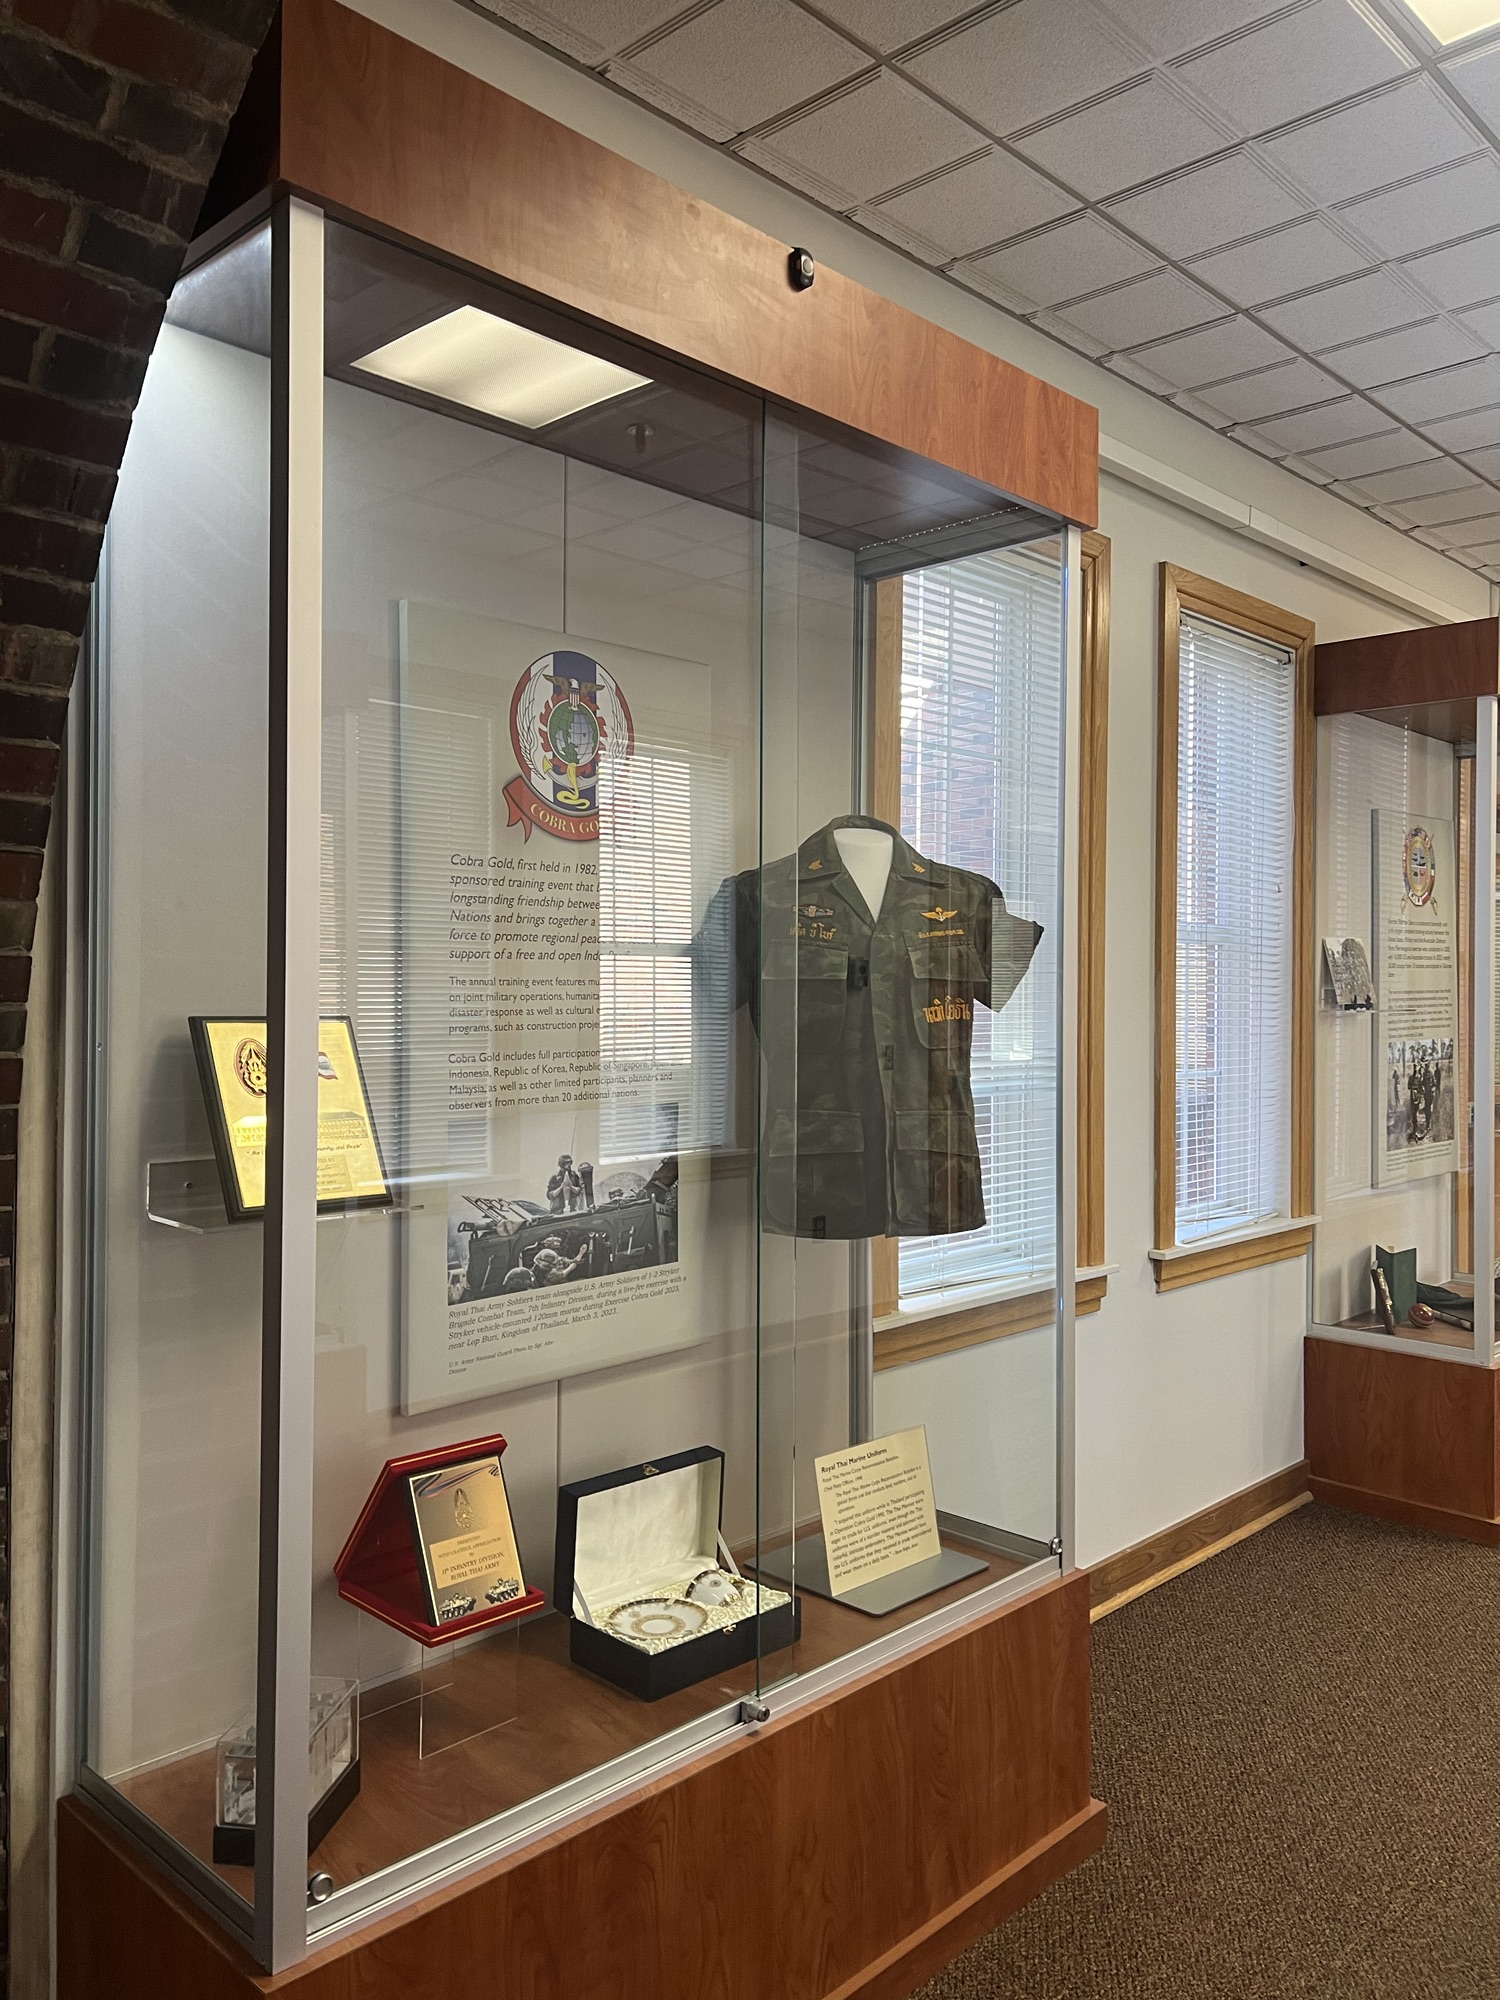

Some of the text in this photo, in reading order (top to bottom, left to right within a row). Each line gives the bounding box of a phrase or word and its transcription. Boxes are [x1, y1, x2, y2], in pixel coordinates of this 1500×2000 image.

[530, 804, 575, 833] COBRA
[451, 854, 483, 867] Cobra
[488, 857, 514, 870] Gold,
[517, 859, 537, 871] first
[540, 861, 560, 872] held
[563, 863, 570, 873] in
[575, 864, 598, 876] 1982,
[450, 875, 505, 887] sponsored
[508, 878, 545, 892] training
[548, 881, 573, 891] event
[576, 881, 594, 892] that
[451, 891, 514, 908] longstanding
[517, 895, 564, 910] friendship
[567, 898, 601, 909] betwee
[450, 910, 595, 928] Nations and brings together a
[450, 929, 476, 940] force
[481, 931, 491, 941] to
[494, 932, 538, 944] promote
[541, 933, 579, 945] regional
[449, 949, 490, 962] support
[494, 949, 506, 960] of
[507, 951, 512, 960] a
[516, 949, 535, 960] free
[538, 949, 554, 960] and
[558, 952, 581, 964] open
[449, 977, 466, 986] The
[469, 977, 496, 986] annual
[499, 978, 529, 988] training
[532, 979, 553, 987] event
[556, 977, 585, 986] features
[450, 991, 600, 1004] on joint military operations, humanita
[450, 1008, 483, 1017] disaster
[486, 1009, 523, 1018] response
[537, 1006, 552, 1015] well
[566, 1006, 594, 1015] cultural
[449, 1021, 600, 1035] programs, such as construction proje
[448, 1053, 476, 1064] Cobra
[479, 1052, 500, 1063] Gold
[503, 1051, 536, 1061] includes
[538, 1050, 550, 1060] full
[553, 1049, 600, 1060] participation
[449, 1069, 491, 1079] Indonesia,
[494, 1067, 528, 1078] Republic
[532, 1065, 540, 1075] of
[542, 1064, 567, 1074] Korea,
[569, 1062, 601, 1074] Republic
[604, 1062, 612, 1070] of
[613, 1060, 650, 1071] Singapore,
[450, 1085, 486, 1096] Malaysia,
[500, 1082, 516, 1091] well
[530, 1081, 552, 1090] other
[554, 1078, 580, 1088] limited
[583, 1076, 627, 1088] participants,
[629, 1074, 658, 1084] planners
[660, 1072, 673, 1080] and
[449, 1101, 492, 1111] observers
[495, 1098, 515, 1107] from
[518, 1097, 539, 1105] more
[543, 1094, 560, 1103] than
[562, 1093, 571, 1102] 20
[574, 1090, 609, 1101] additional
[449, 1308, 468, 1319] Royal
[471, 1305, 485, 1314] Thai
[487, 1303, 506, 1311] Army
[507, 1297, 533, 1307] Soldiers
[535, 1293, 551, 1301] train
[552, 1286, 582, 1298] alongside
[584, 1283, 596, 1292] U.S.
[598, 1280, 615, 1289] Army
[616, 1276, 640, 1285] Soldiers
[641, 1272, 648, 1280] of
[659, 1268, 680, 1277] Stryker
[449, 1318, 476, 1329] Brigade
[478, 1313, 504, 1323] Combat
[506, 1309, 525, 1317] Team,
[541, 1300, 567, 1310] Infantry
[568, 1295, 594, 1304] Division,
[596, 1290, 617, 1299] during
[623, 1283, 645, 1293] live-fire
[646, 1280, 669, 1289] exercise
[449, 1328, 475, 1340] Stryker
[477, 1316, 531, 1333] vehicle-mounted
[534, 1312, 558, 1321] 120mm
[560, 1306, 581, 1316] mortar
[583, 1302, 603, 1311] during
[605, 1297, 629, 1306] Exercise
[631, 1292, 649, 1301] Cobra
[650, 1289, 664, 1297] Gold
[448, 1341, 465, 1350] near
[467, 1337, 480, 1346] Lop
[482, 1335, 499, 1343] Buri,
[501, 1327, 530, 1339] Kingdom
[532, 1324, 539, 1332] of
[540, 1318, 569, 1330] Thailand,
[571, 1314, 591, 1323] March
[821, 1448, 887, 1473] Royal Thai Marine Uniform
[450, 1560, 477, 1572] INFANTRY
[451, 1561, 500, 1581] ROYAL THAI ARMY
